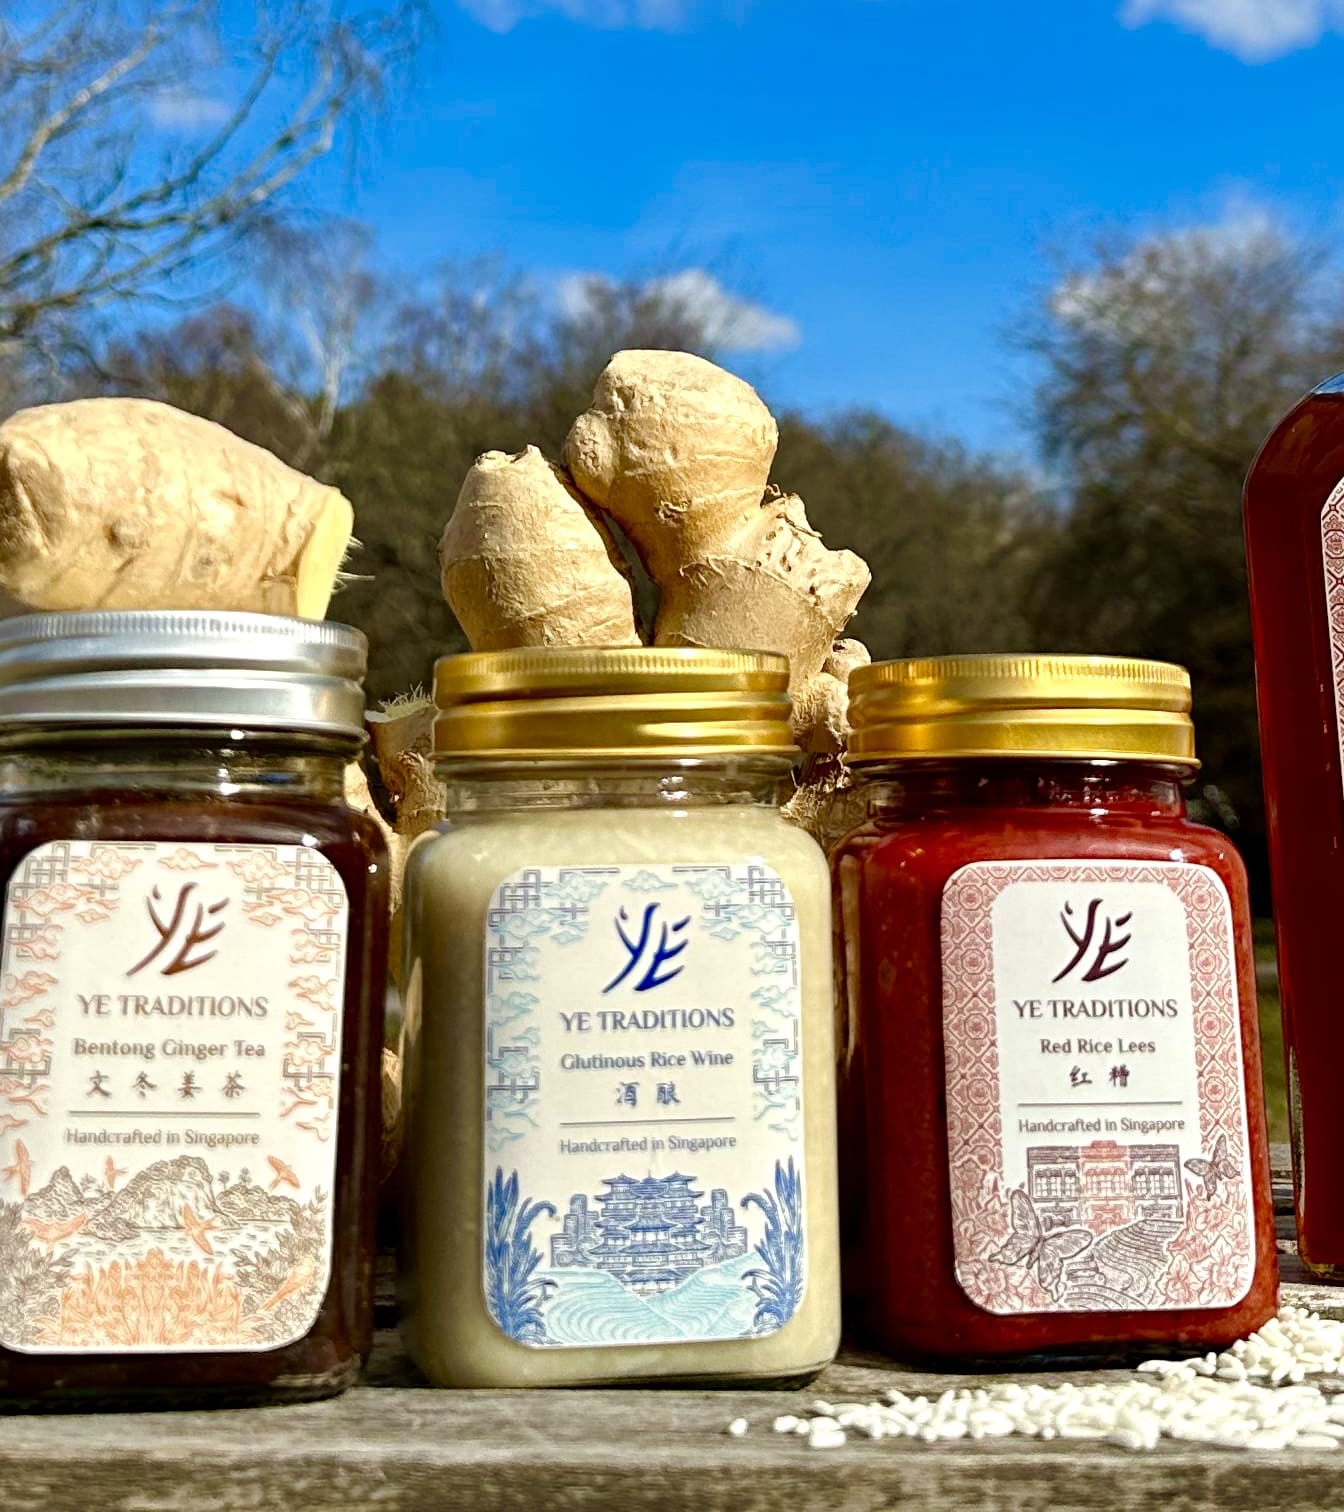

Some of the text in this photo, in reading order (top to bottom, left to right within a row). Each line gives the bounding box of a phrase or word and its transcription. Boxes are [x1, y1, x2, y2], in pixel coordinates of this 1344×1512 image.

[78, 995, 268, 1017] YE TRADITIONS
[1013, 999, 1177, 1018] YE TRADITIONS
[560, 1008, 734, 1032] YE TRADITIONS
[74, 1038, 265, 1060] Bentong Ginger Tea
[1041, 1039, 1155, 1053] Red Rice Lees
[560, 1051, 733, 1070] Glutinous Rice Wine
[1019, 1117, 1185, 1134] Handcrafted in Singapore
[64, 1128, 260, 1148] Handcrafted in Singapore
[560, 1135, 736, 1155] Handcrafted in Singapore
